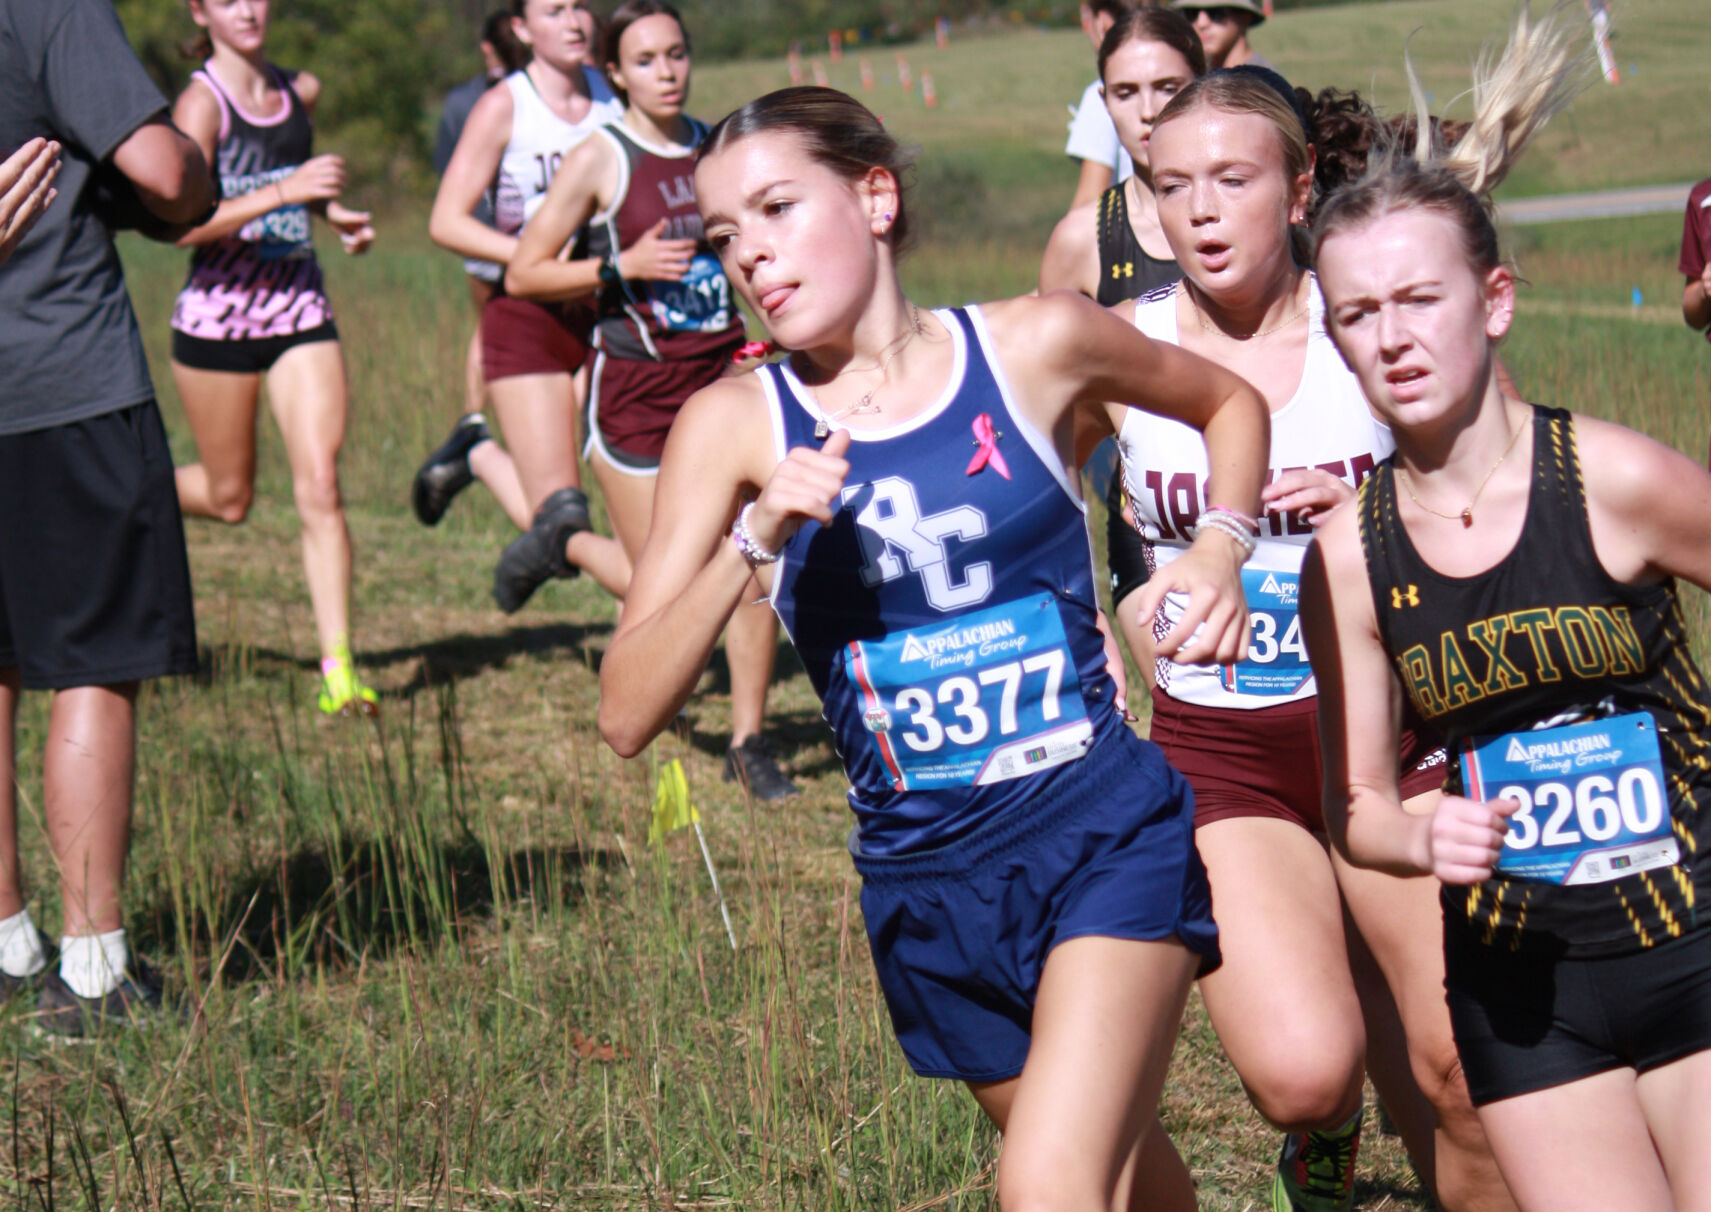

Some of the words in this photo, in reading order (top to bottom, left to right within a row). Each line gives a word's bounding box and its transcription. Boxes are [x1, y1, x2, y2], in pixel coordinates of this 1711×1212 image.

[841, 475, 993, 612] RC
[924, 649, 975, 670] Timing
[978, 635, 1027, 657] Group
[1397, 606, 1646, 721] RAXTON
[895, 650, 1066, 752] 3377
[1524, 758, 1572, 774] Timing
[1575, 749, 1622, 766] Group
[1498, 767, 1664, 850] 3260
